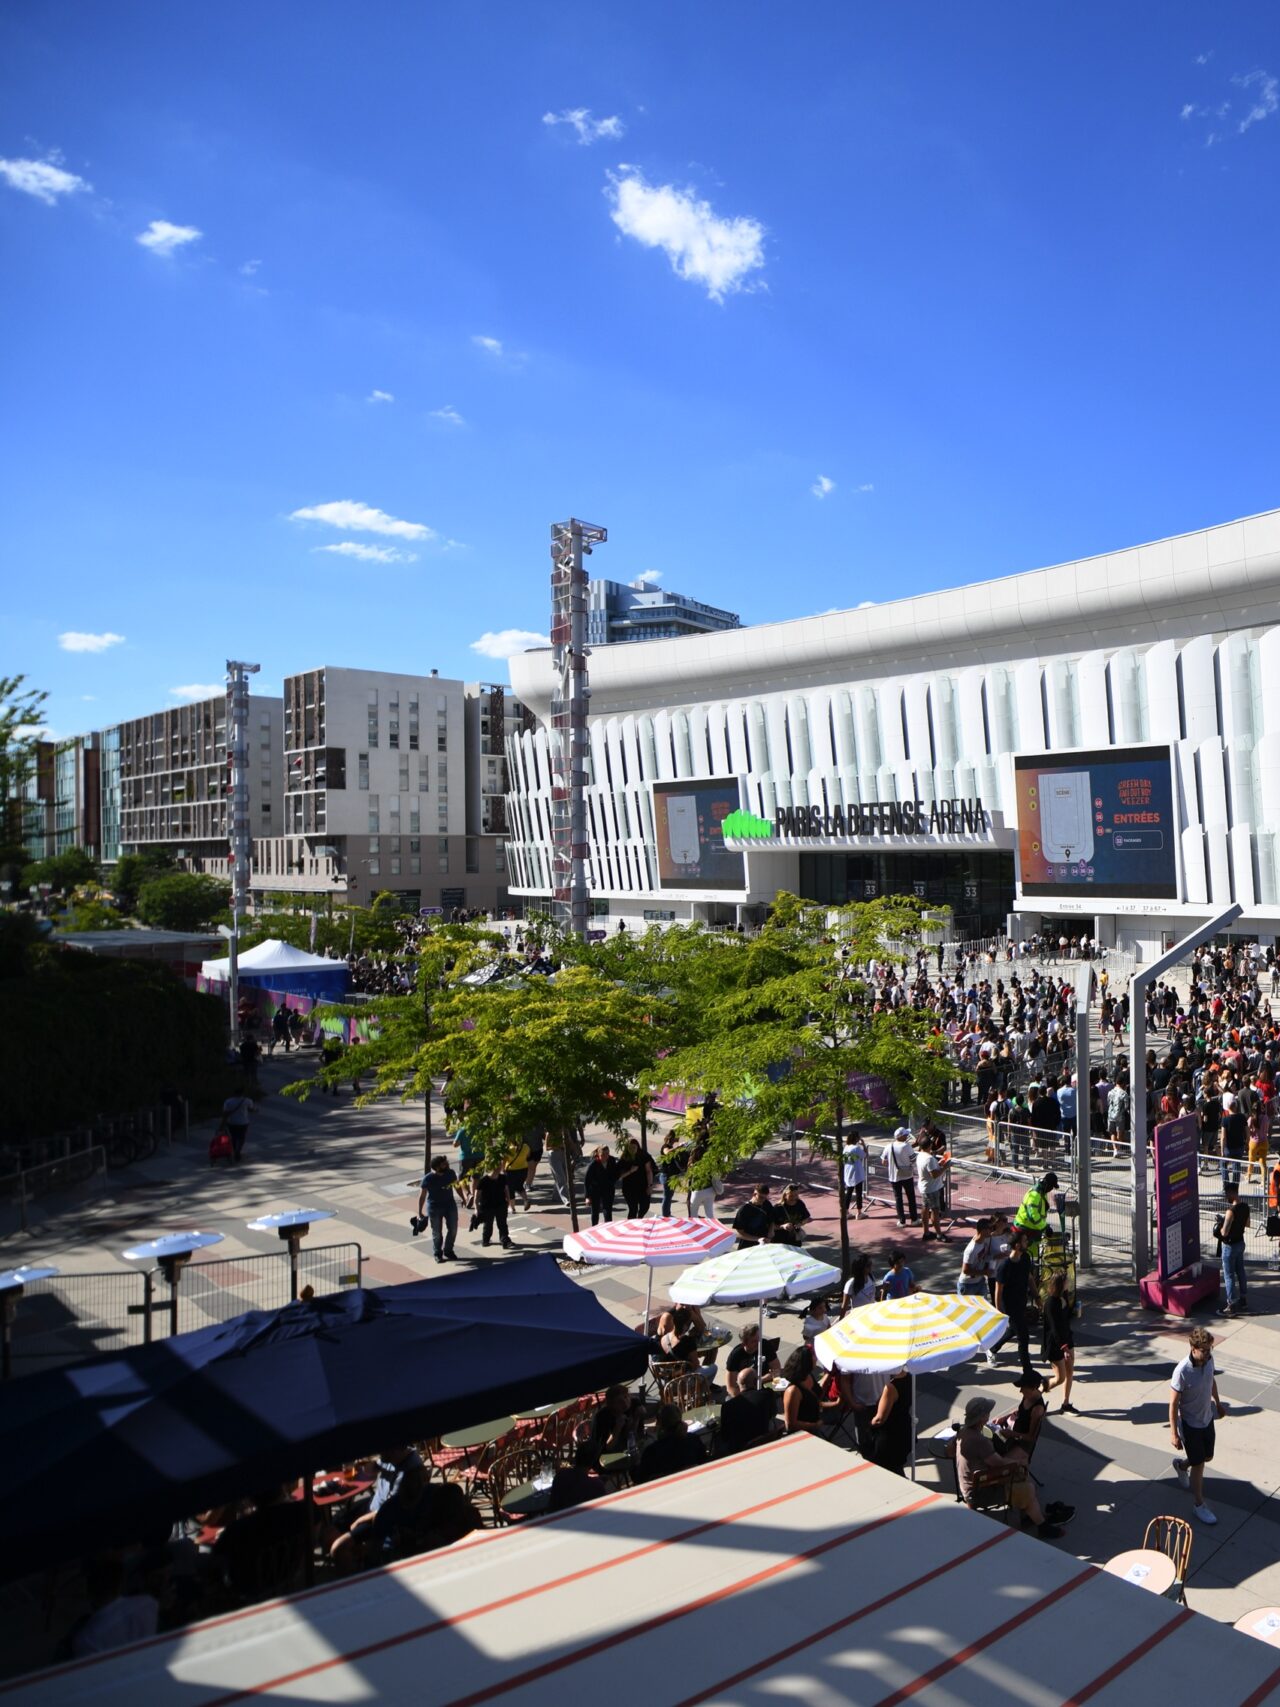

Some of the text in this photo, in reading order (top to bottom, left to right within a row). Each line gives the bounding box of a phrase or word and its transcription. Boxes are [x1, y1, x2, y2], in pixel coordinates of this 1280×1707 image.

[775, 797, 988, 838] PARIS LA DEFENSE ARENA
[1113, 811, 1160, 824] ENTRÉES
[865, 885, 876, 895] 33
[914, 886, 925, 896] 33
[965, 887, 977, 897] 33
